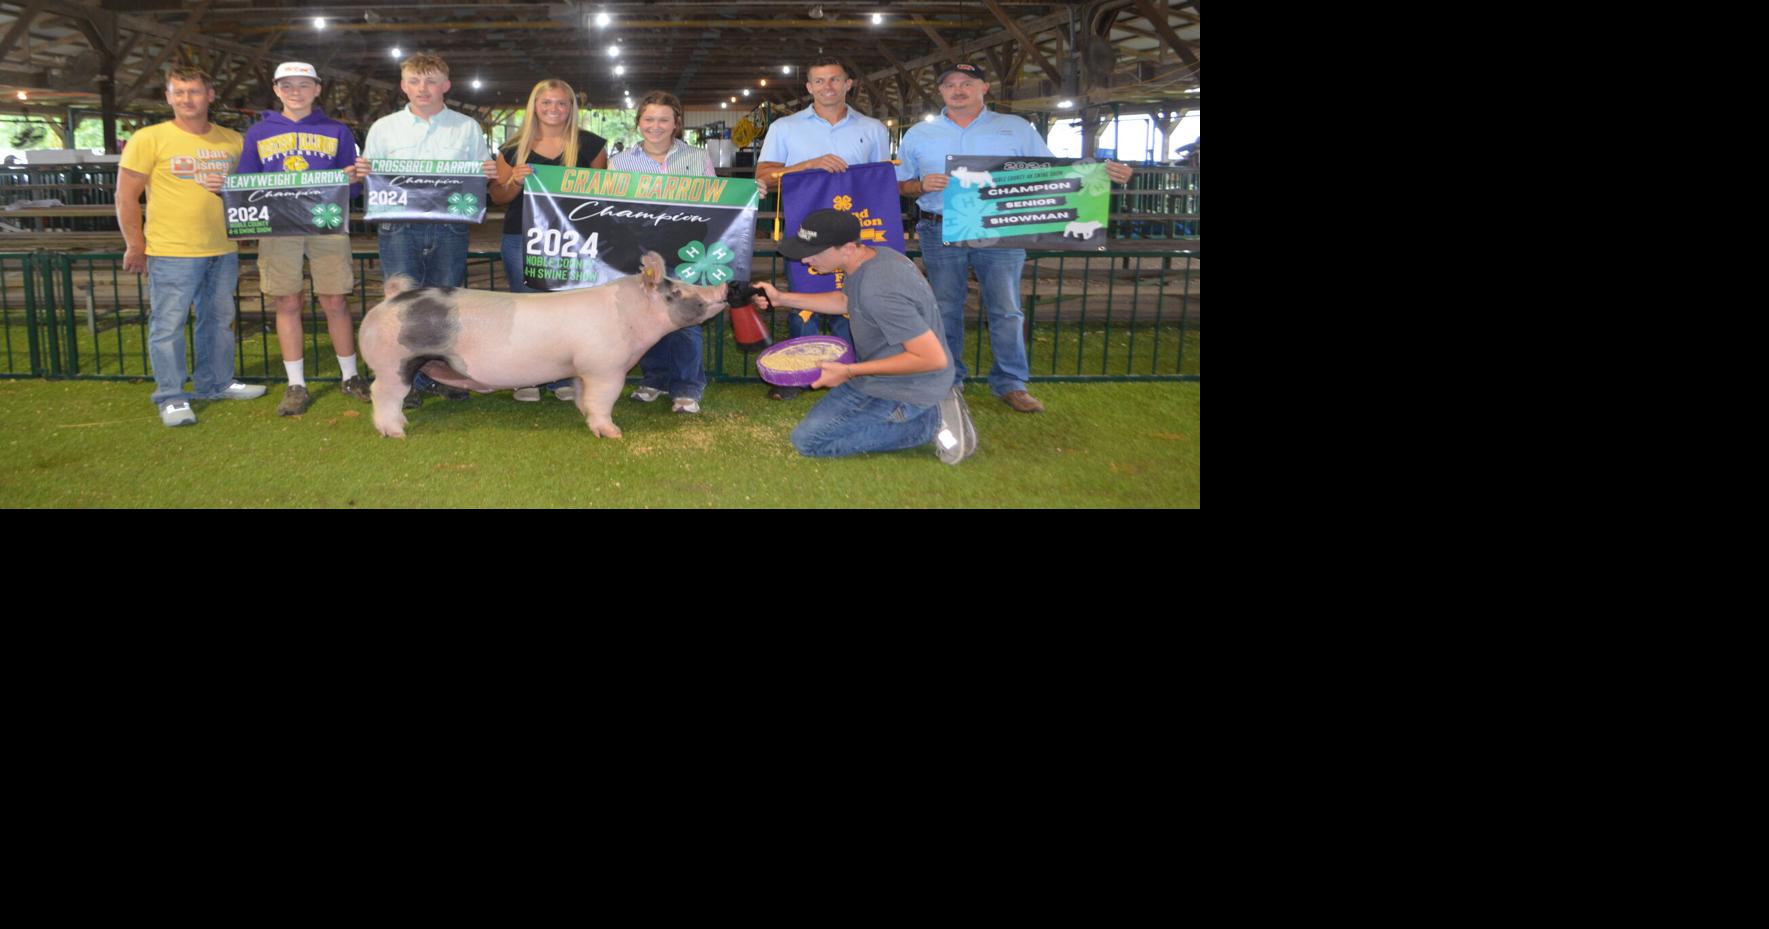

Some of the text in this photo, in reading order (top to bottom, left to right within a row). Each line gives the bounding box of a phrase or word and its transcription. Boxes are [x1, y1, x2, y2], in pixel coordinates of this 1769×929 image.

[371, 160, 483, 174] CROSSBRED BARROW
[224, 173, 297, 189] HEAVYWEIGHT
[301, 170, 344, 185] BARROW
[388, 175, 464, 187] Champion
[560, 168, 728, 203] GRAND BARROW
[248, 189, 326, 203] Champion
[987, 181, 1071, 196] CHAMPION
[368, 190, 408, 206] 2024
[1005, 198, 1057, 209] SENIOR
[228, 206, 270, 223] 2024
[568, 201, 711, 227] Champion
[990, 211, 1069, 225] SHOWMAN
[526, 227, 599, 259] 2024
[525, 255, 555, 268] NOBLE
[537, 268, 568, 281] SWINE
[570, 271, 599, 283] SHOW
